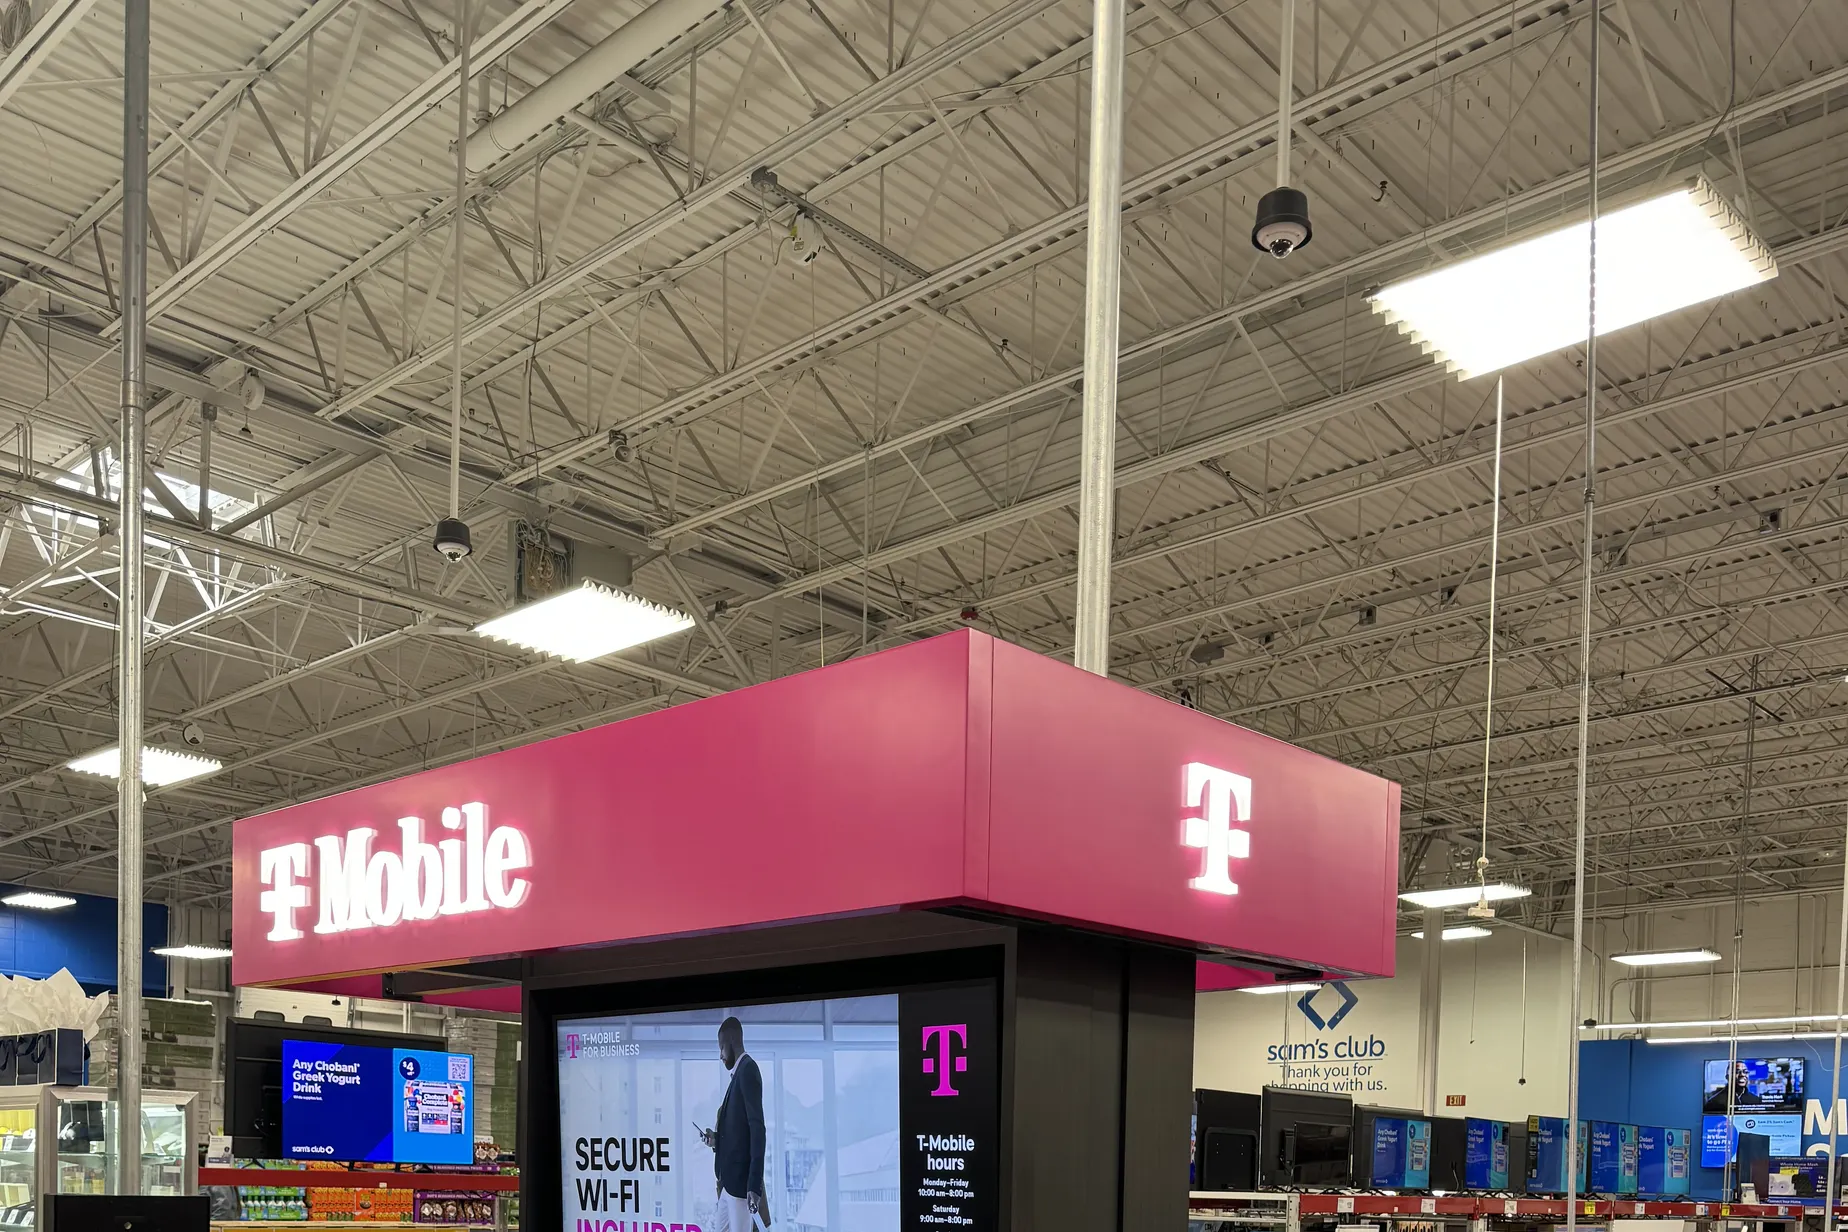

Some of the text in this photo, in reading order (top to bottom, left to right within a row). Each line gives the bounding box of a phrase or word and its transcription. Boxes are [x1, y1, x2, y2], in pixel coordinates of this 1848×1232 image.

[1180, 762, 1252, 896] T
[313, 801, 532, 935] Mobile
[582, 1031, 621, 1046] T-MOBILE
[583, 1044, 640, 1059] FOR BUSINESS
[1267, 1034, 1385, 1061] sam's club
[293, 1059, 313, 1072] Any
[922, 1024, 968, 1097] T
[293, 1072, 361, 1085] Greek Yogurt
[1324, 1067, 1349, 1081] you
[1353, 1062, 1373, 1076] for
[293, 1082, 322, 1094] Drink
[1333, 1078, 1363, 1091] with
[1367, 1080, 1387, 1091] us.
[916, 1134, 975, 1152] T-Mobile
[575, 1136, 670, 1172] SECURE
[927, 1153, 965, 1171] hours
[576, 1178, 640, 1213] WI-FI
[918, 1189, 935, 1197] 10:00
[964, 1190, 975, 1199] pm
[932, 1204, 960, 1215] Saturday
[919, 1215, 934, 1223] 9:00
[963, 1218, 973, 1226] pm
